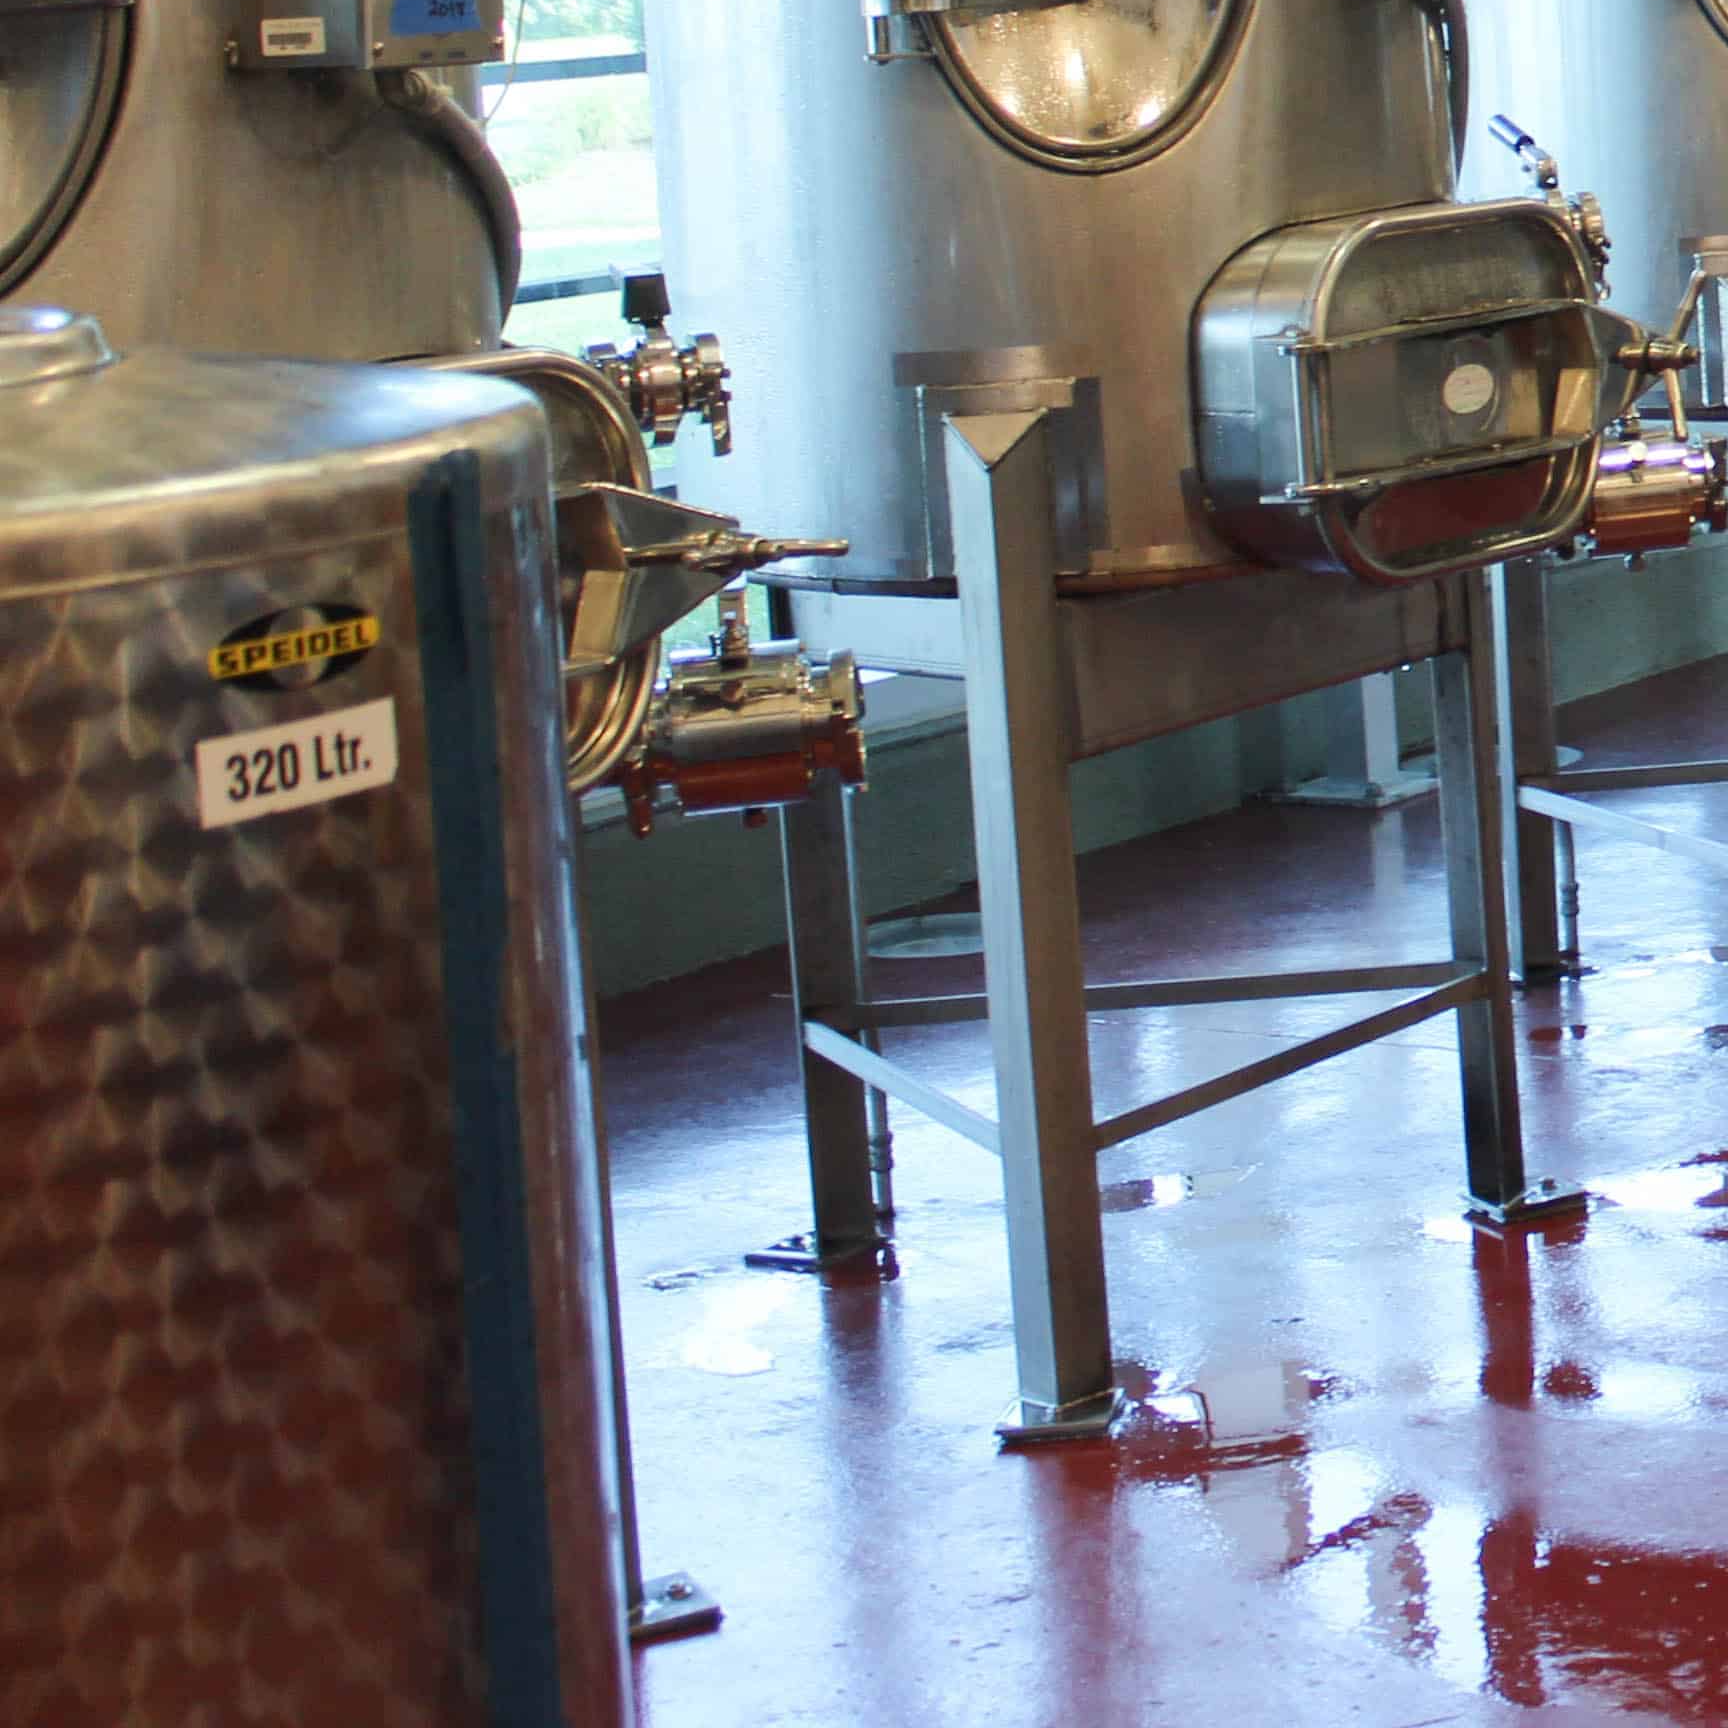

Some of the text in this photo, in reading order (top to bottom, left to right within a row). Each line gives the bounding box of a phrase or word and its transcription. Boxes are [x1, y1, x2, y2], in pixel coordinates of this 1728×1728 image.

[215, 622, 370, 671] SPEIDEL
[226, 731, 371, 803] 320 Ltr.
